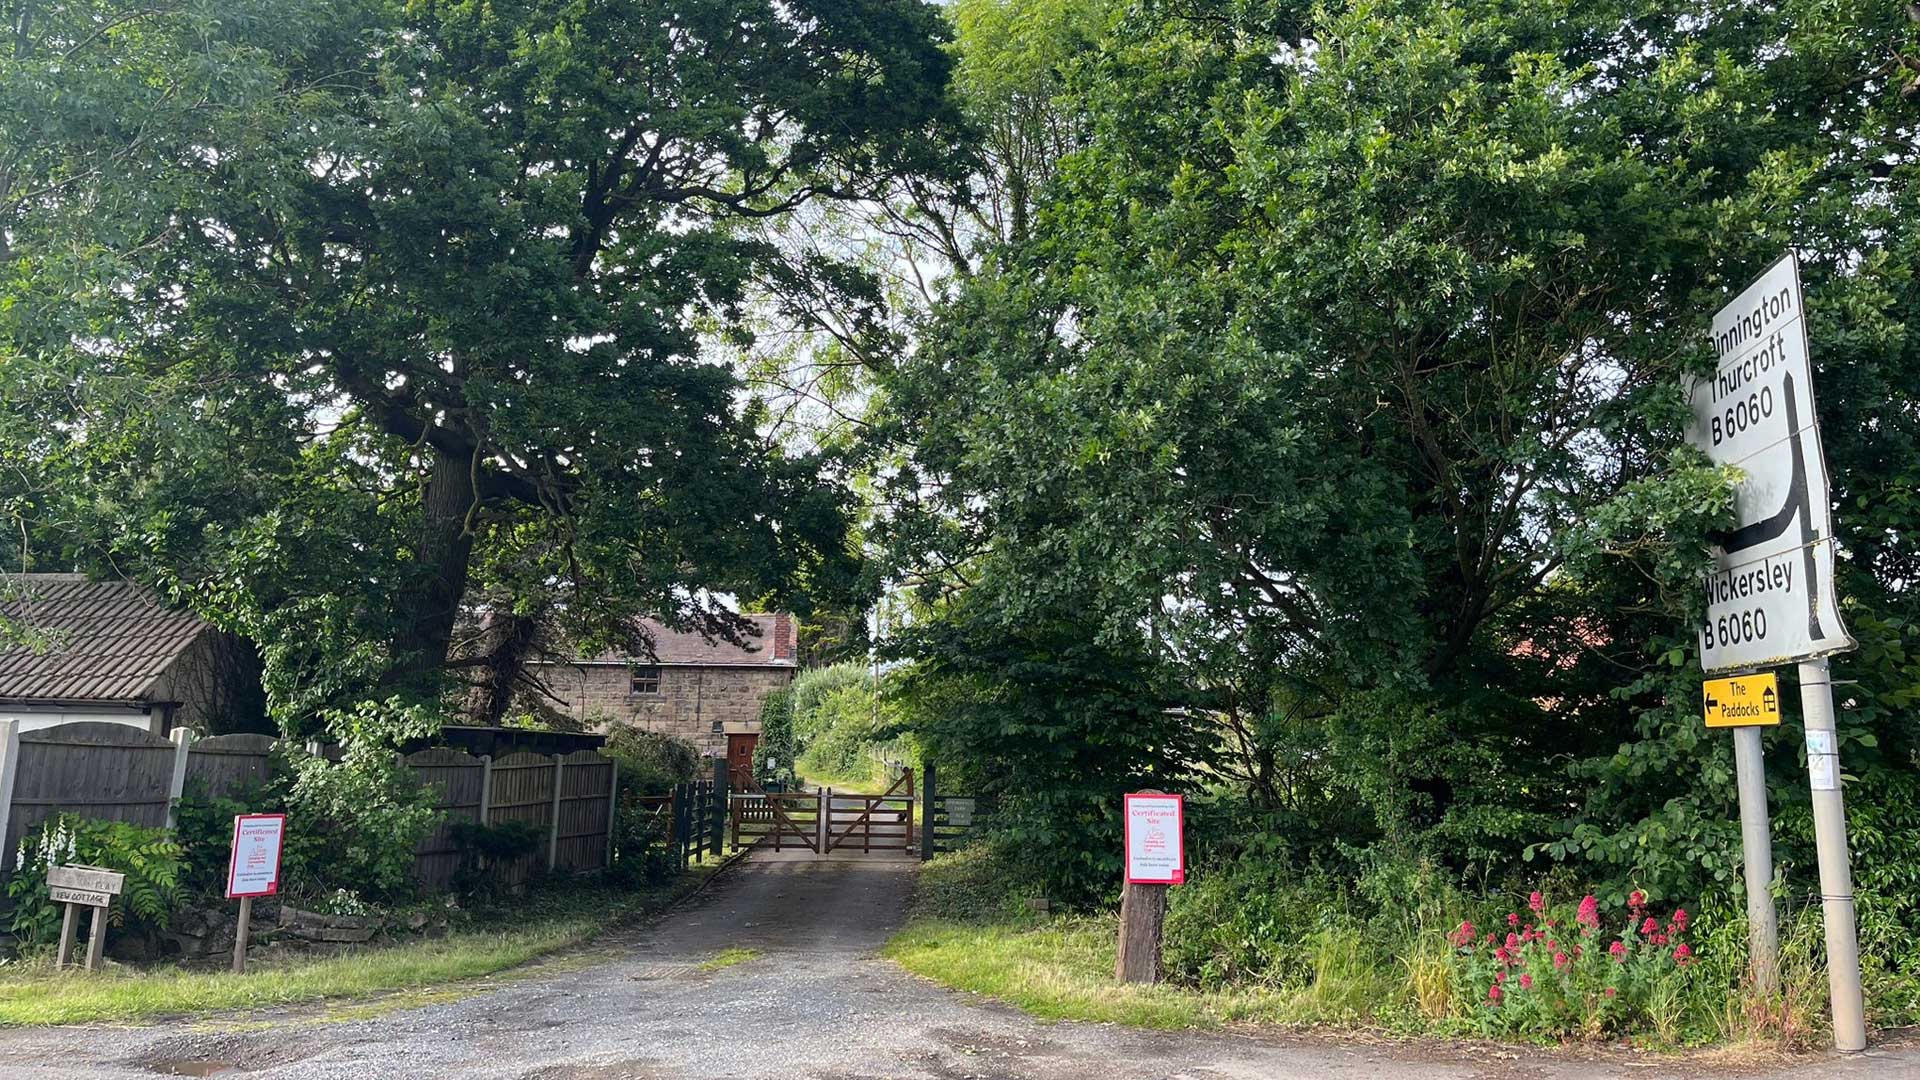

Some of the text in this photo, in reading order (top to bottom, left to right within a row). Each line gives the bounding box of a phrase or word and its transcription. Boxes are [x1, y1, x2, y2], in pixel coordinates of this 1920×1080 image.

[1709, 331, 1786, 403] Thurcroft
[1729, 681, 1746, 696] The
[1722, 701, 1760, 718] Paddocks
[1132, 809, 1175, 817] Certificated
